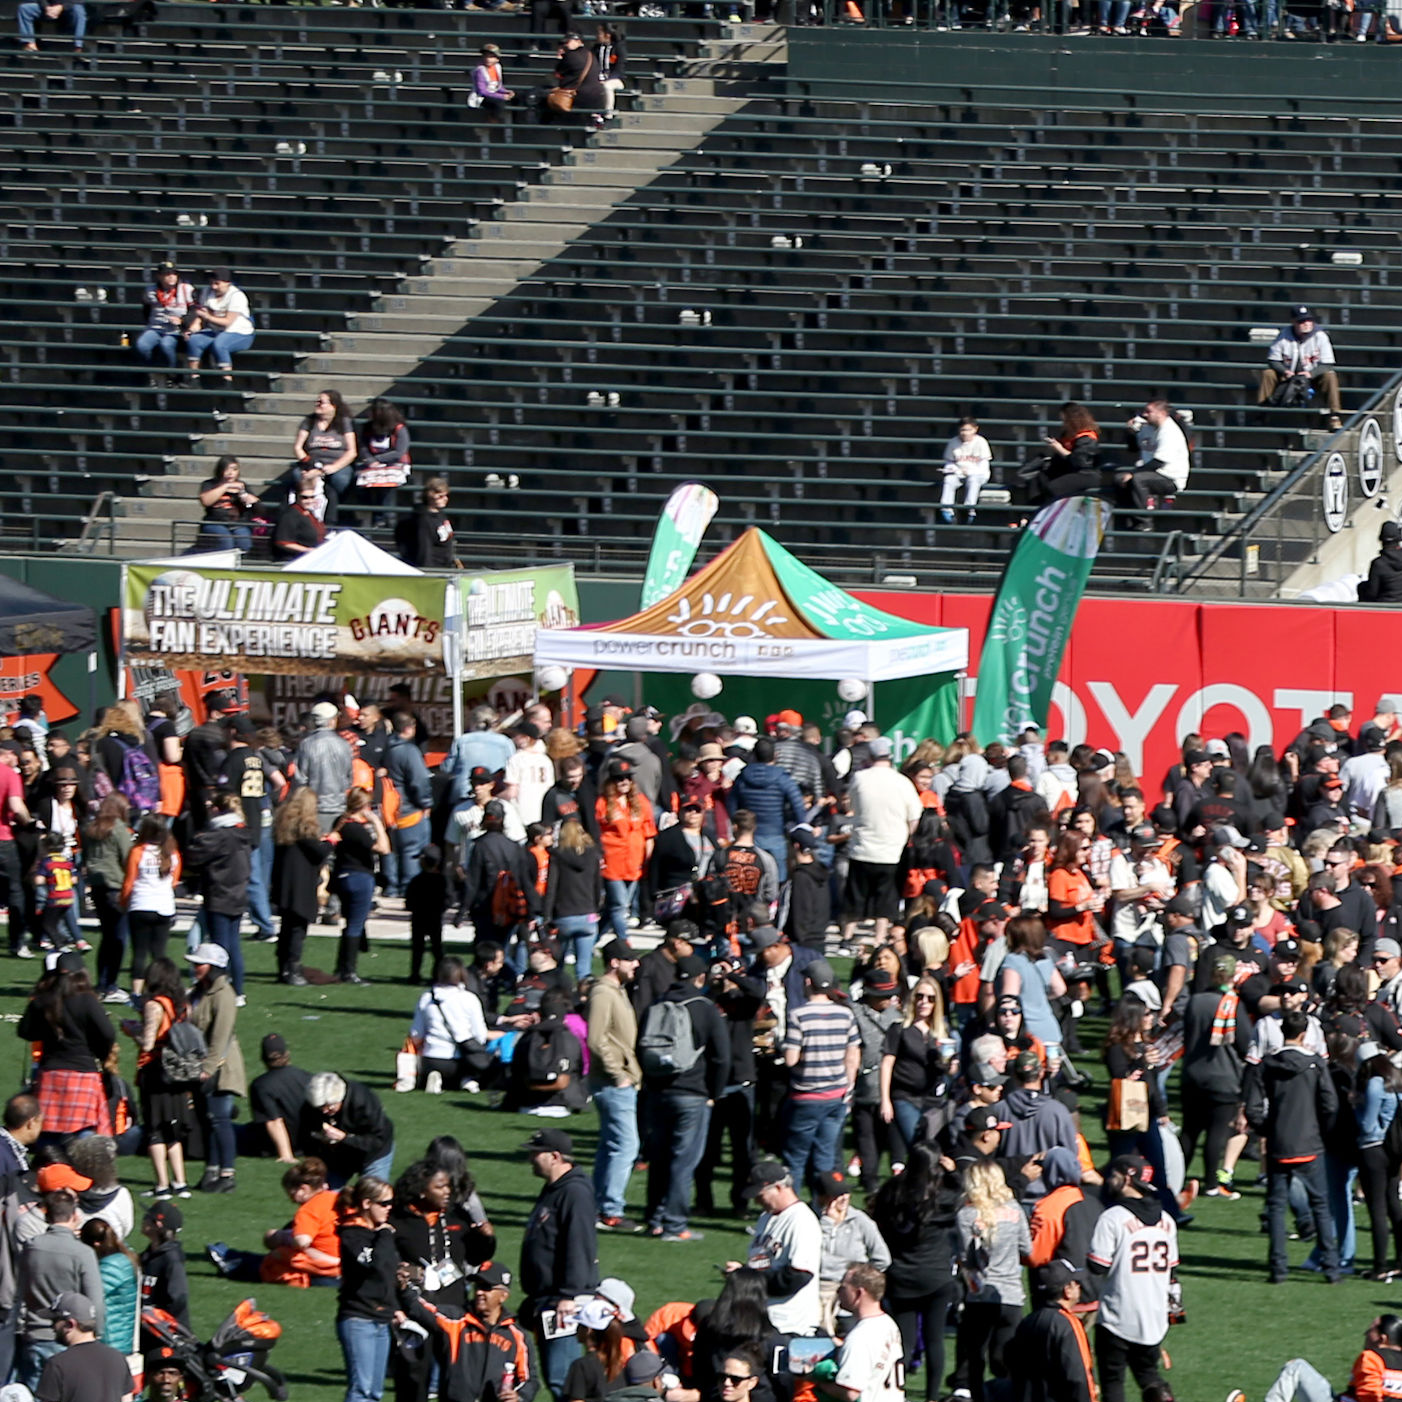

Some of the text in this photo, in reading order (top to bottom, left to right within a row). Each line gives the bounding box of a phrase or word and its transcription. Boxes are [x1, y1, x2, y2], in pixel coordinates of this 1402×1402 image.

[149, 580, 342, 624] THE ULTIMATE
[149, 620, 338, 659] FAN EXPERIENCE
[349, 613, 441, 644] GIANTS
[592, 637, 736, 659] powercrunch
[998, 564, 1068, 747] wercrunch
[1131, 1240, 1169, 1275] 23
